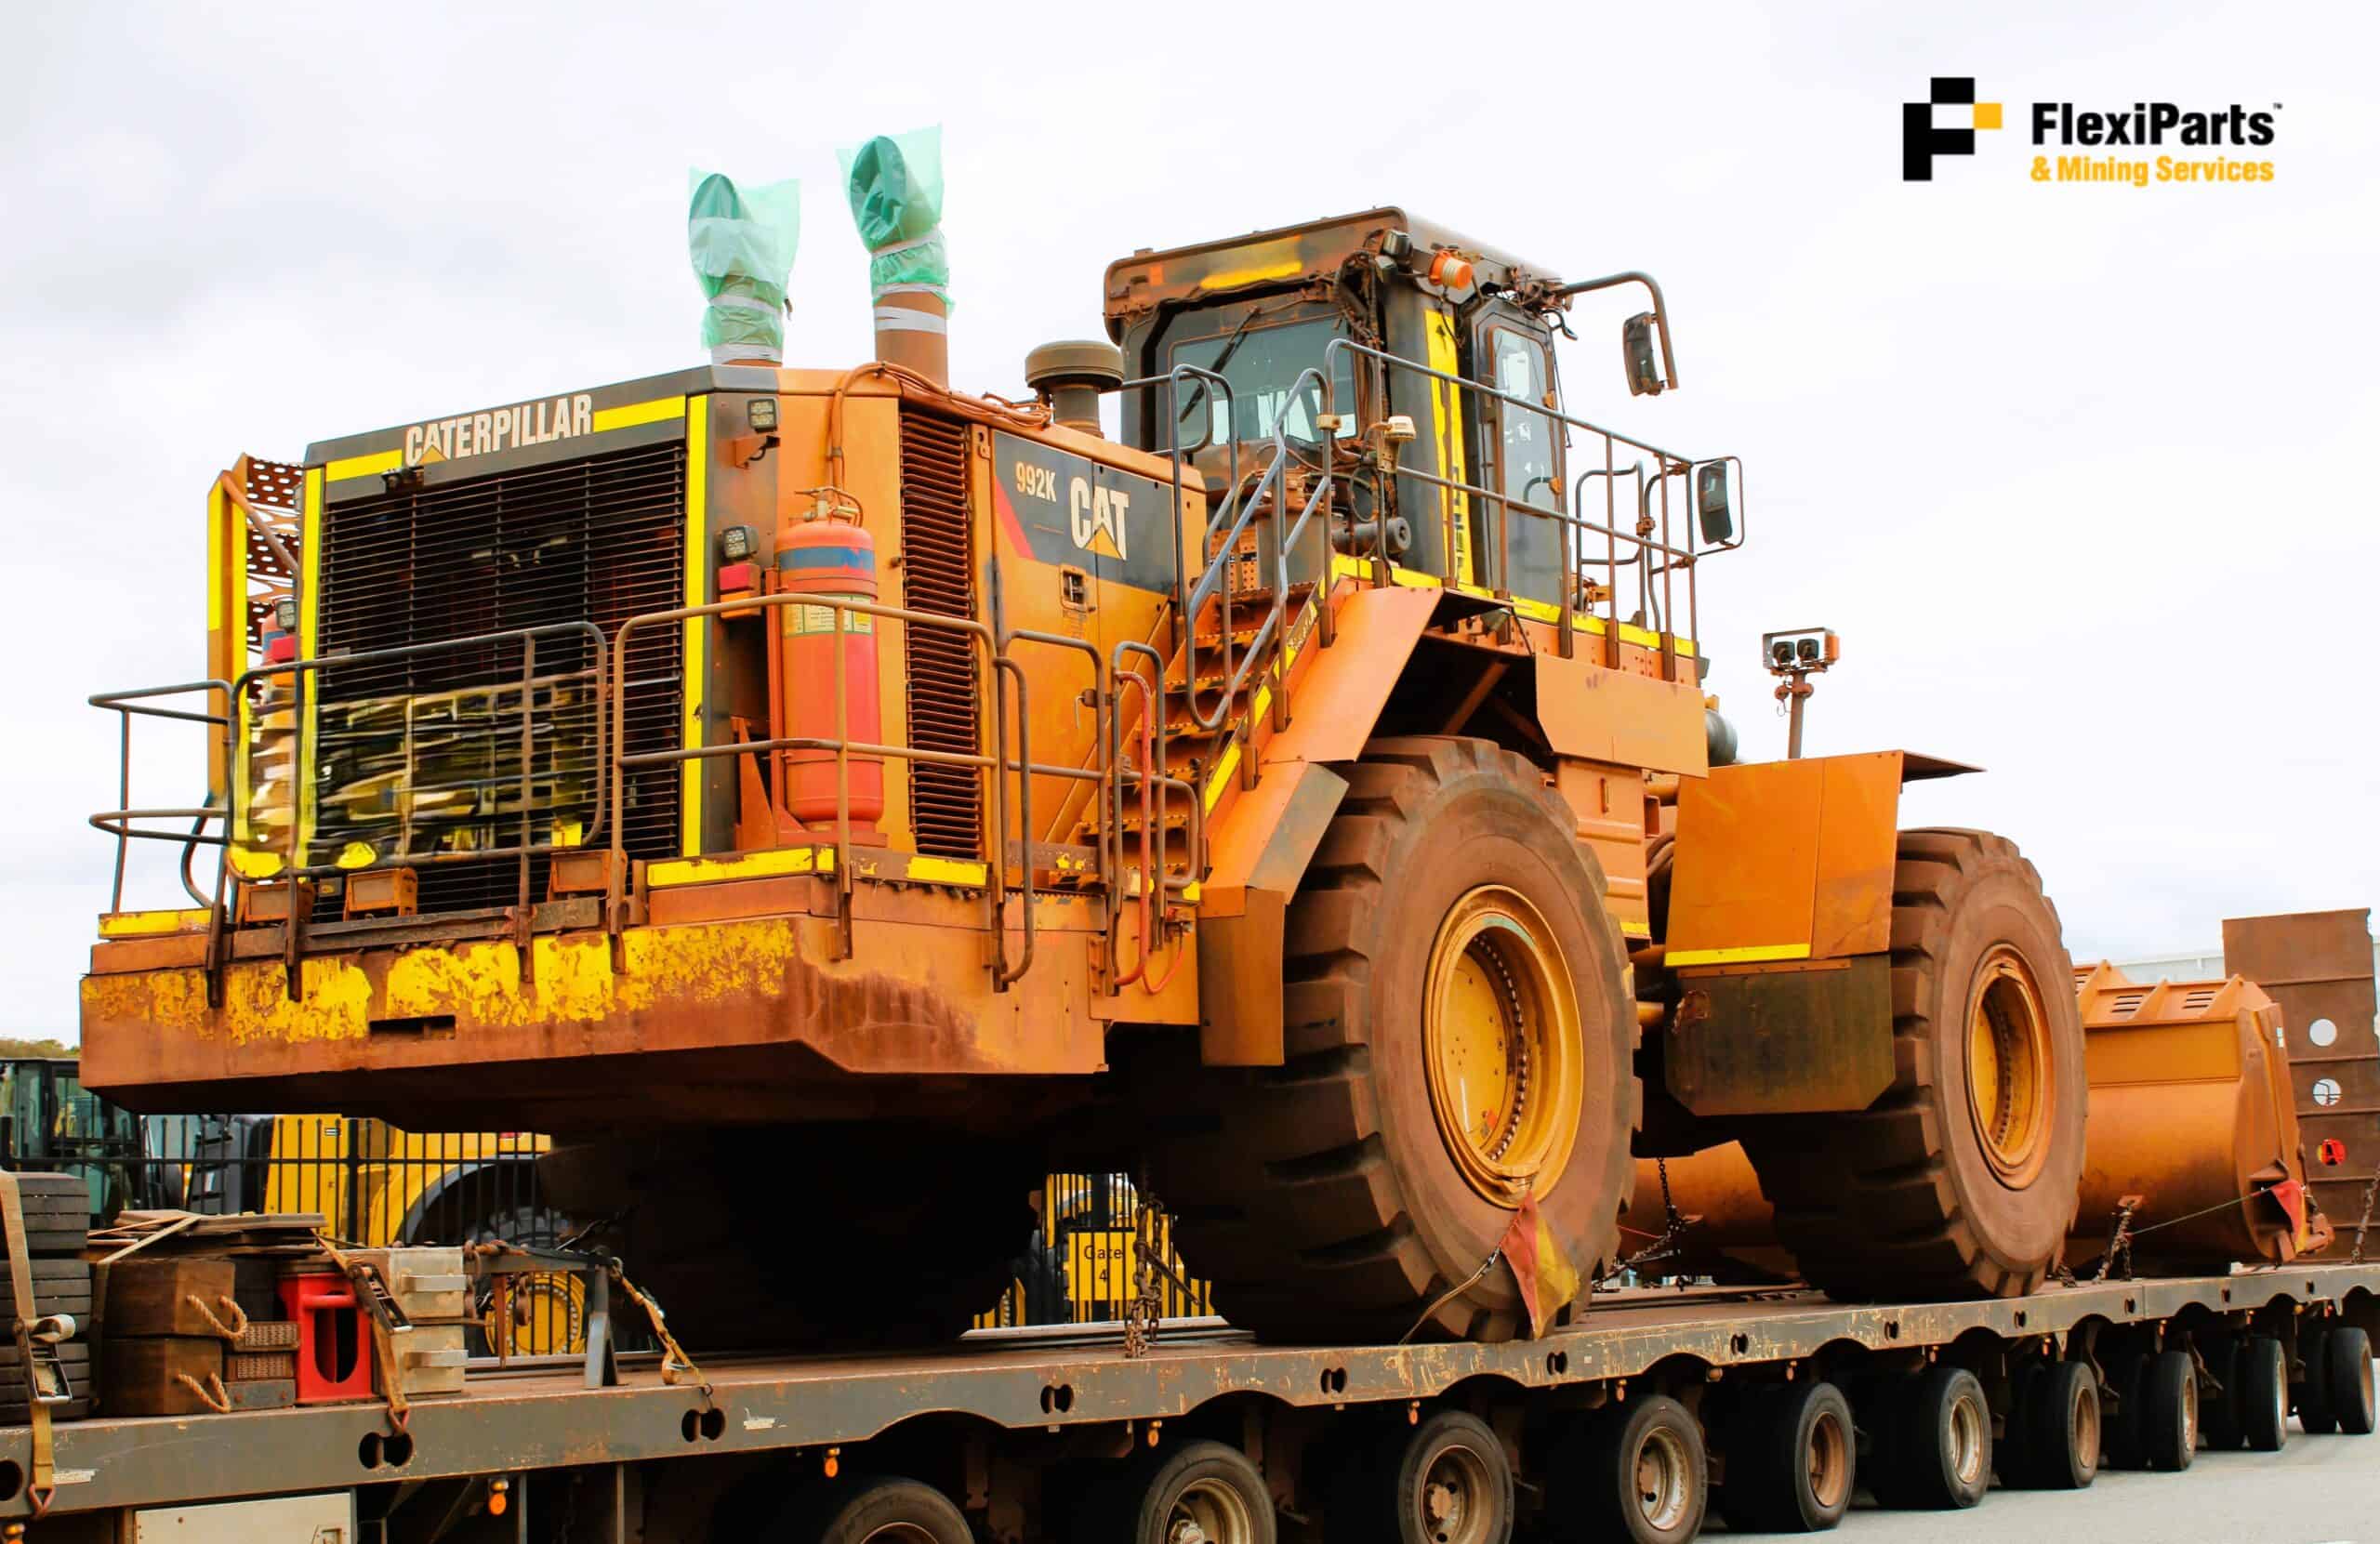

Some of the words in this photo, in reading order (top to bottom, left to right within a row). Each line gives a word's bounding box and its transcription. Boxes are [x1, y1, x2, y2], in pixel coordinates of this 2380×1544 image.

[404, 394, 592, 465] CATERPILLAR
[1015, 462, 1057, 503] 992K
[1071, 477, 1130, 561] CAT
[1099, 1269, 1109, 1282] 4
